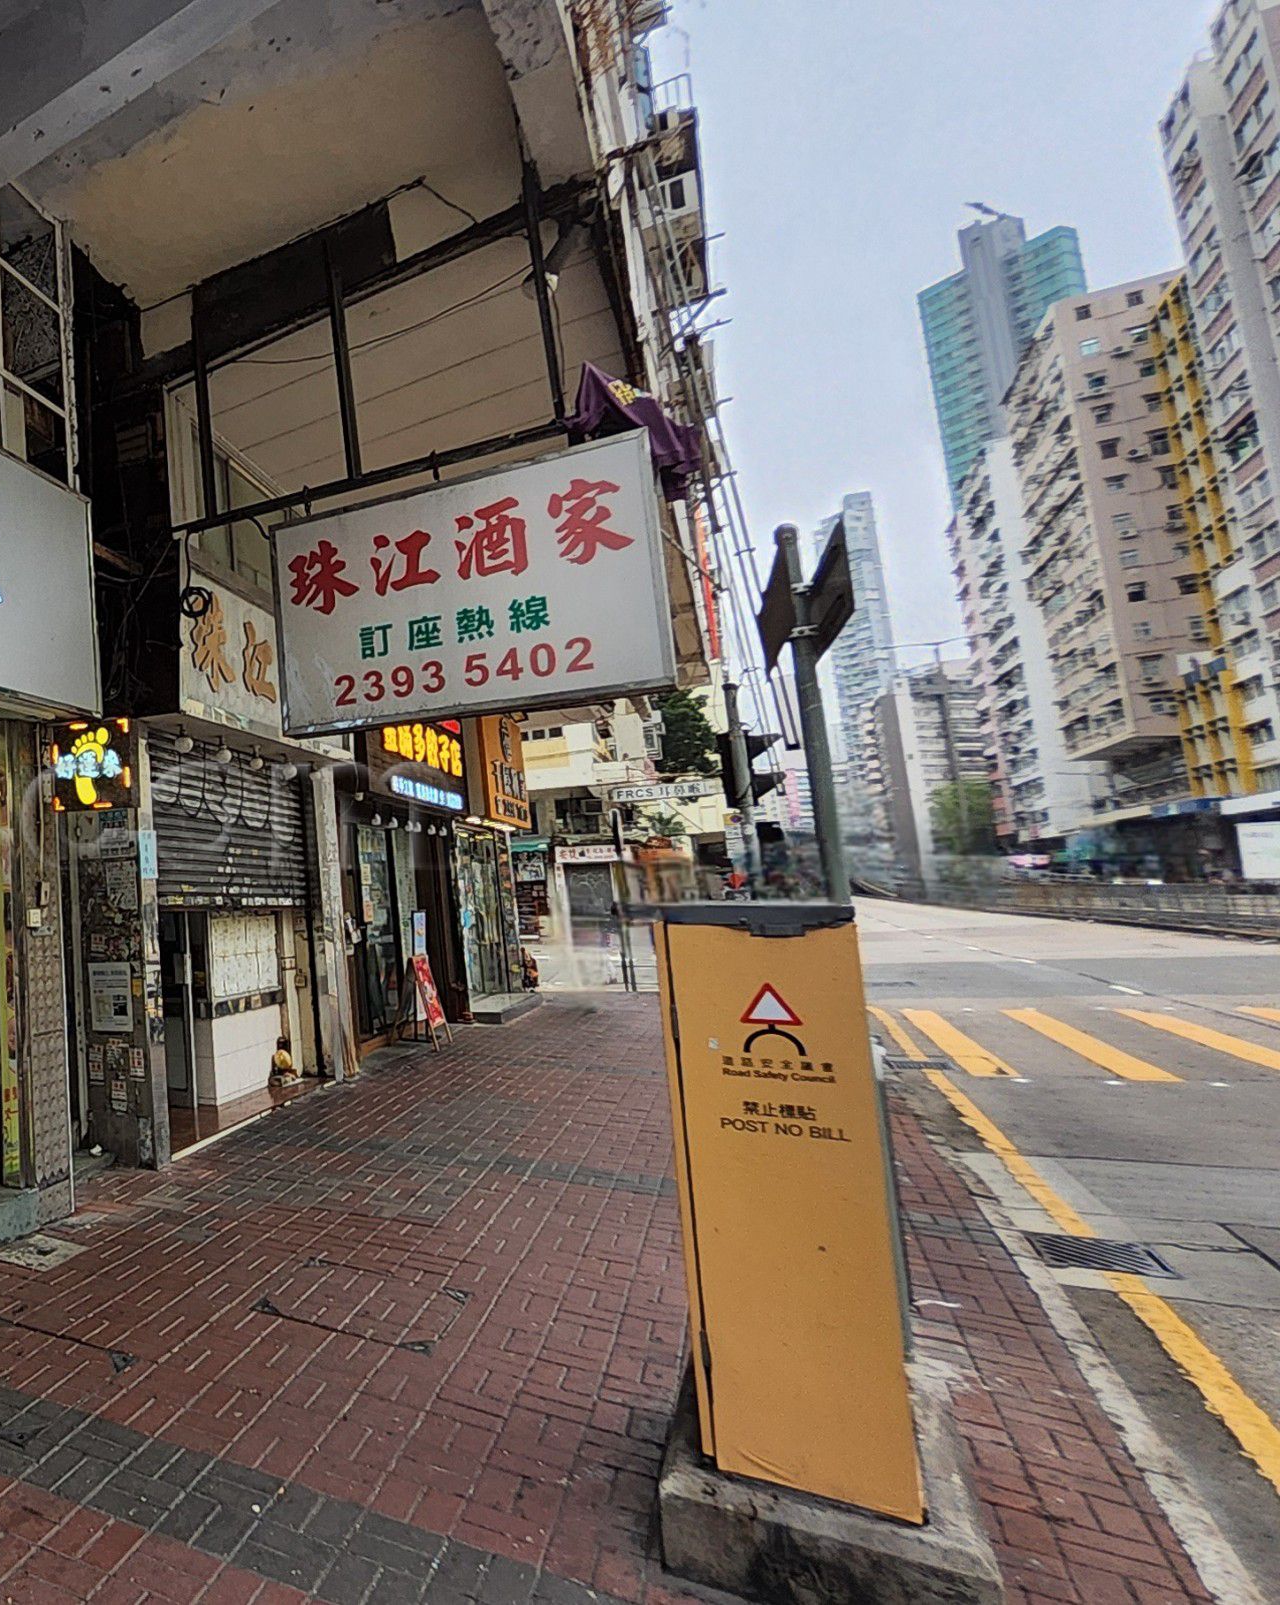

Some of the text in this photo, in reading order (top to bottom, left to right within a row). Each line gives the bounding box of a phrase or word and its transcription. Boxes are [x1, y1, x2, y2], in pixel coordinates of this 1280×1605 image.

[287, 478, 636, 616] 珠江酒家
[359, 595, 551, 661] 訂座熱線
[333, 636, 595, 708] 2393 5402
[616, 787, 654, 800] FRCS
[722, 1067, 838, 1084] Road Safety Council
[720, 1116, 852, 1142] POST NO BILL
